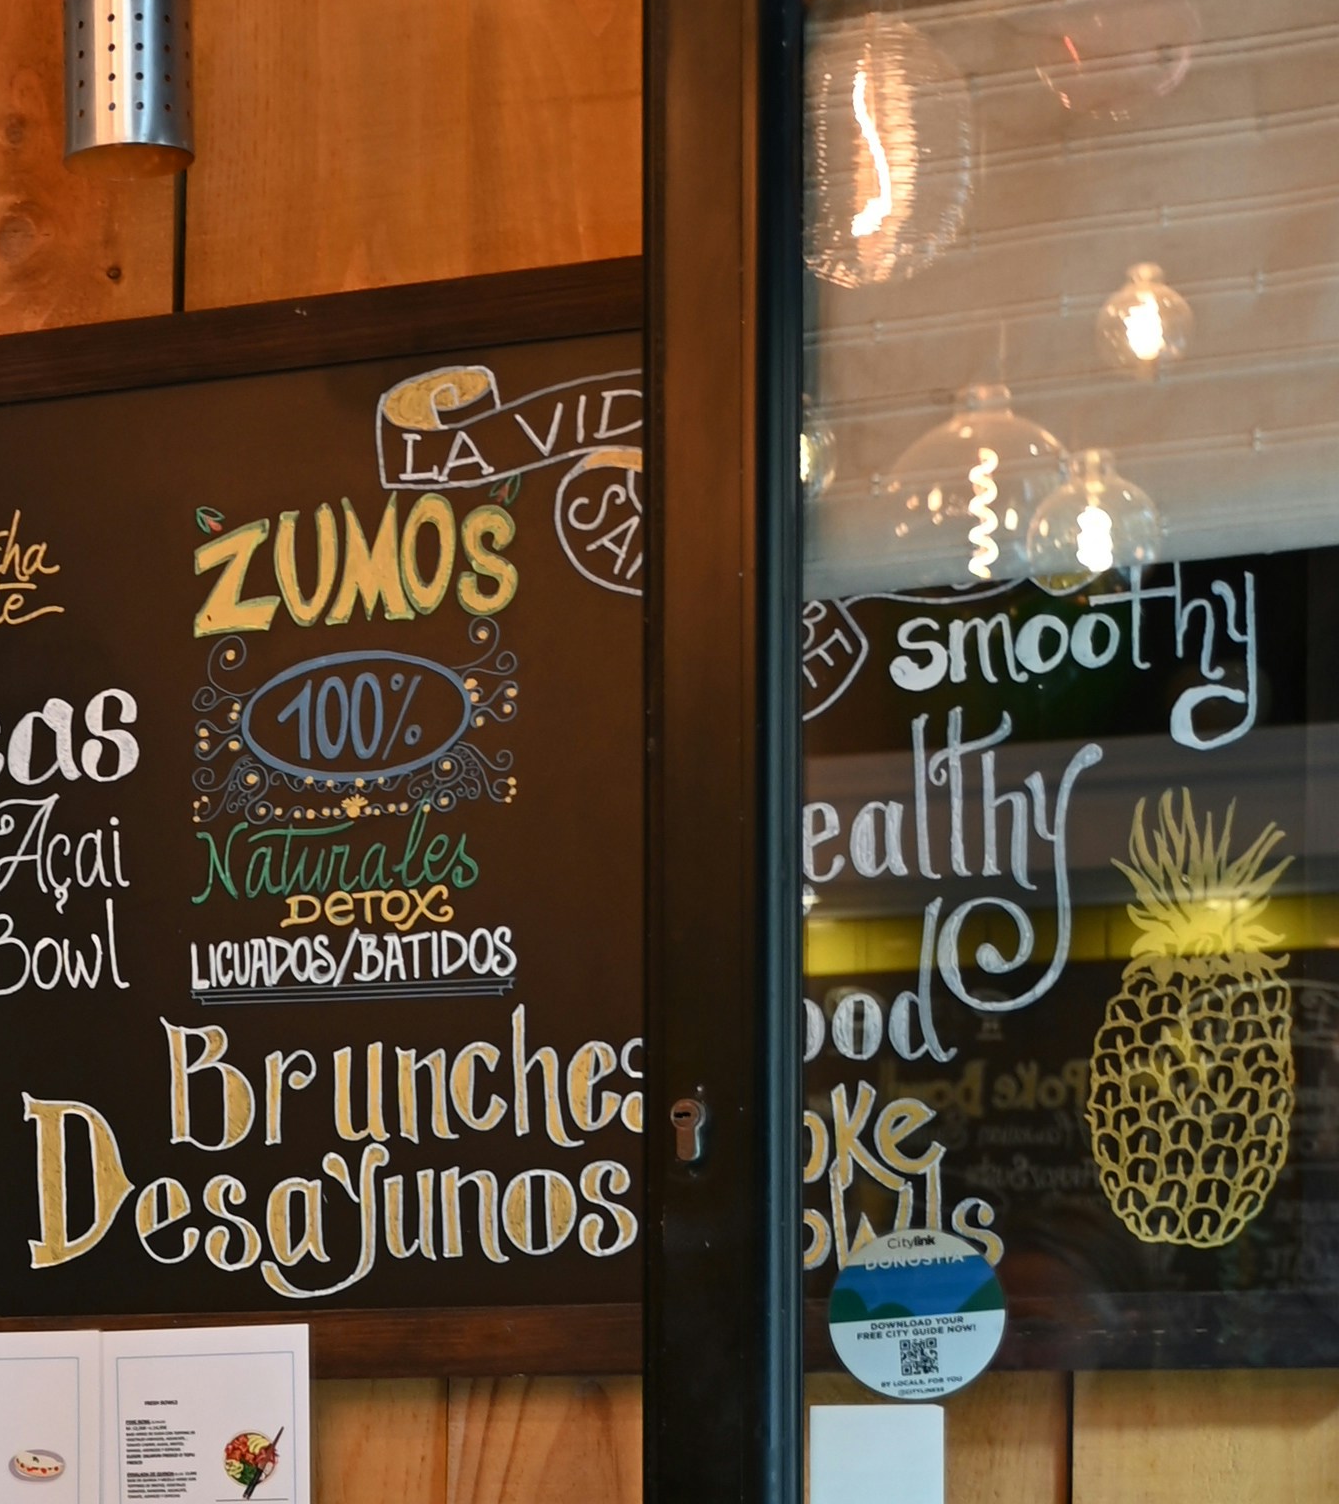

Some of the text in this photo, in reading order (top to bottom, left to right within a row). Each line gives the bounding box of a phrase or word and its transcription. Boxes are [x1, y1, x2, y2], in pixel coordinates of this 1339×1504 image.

[399, 388, 642, 484] LA VID
[193, 492, 518, 638] ZUMOS
[277, 672, 423, 762] 100%
[191, 794, 479, 904] Naturales
[803, 705, 1104, 1012] ealthy
[191, 926, 518, 991] LICUADOS/BATIDOS
[803, 896, 958, 1063] ood
[22, 1090, 638, 1298] Desayunos
[887, 1235, 936, 1250] Citylink
[856, 1324, 977, 1340] FREE CITY GUIDE NOW!
[870, 1316, 964, 1331] DOWNLOAD YOUR
